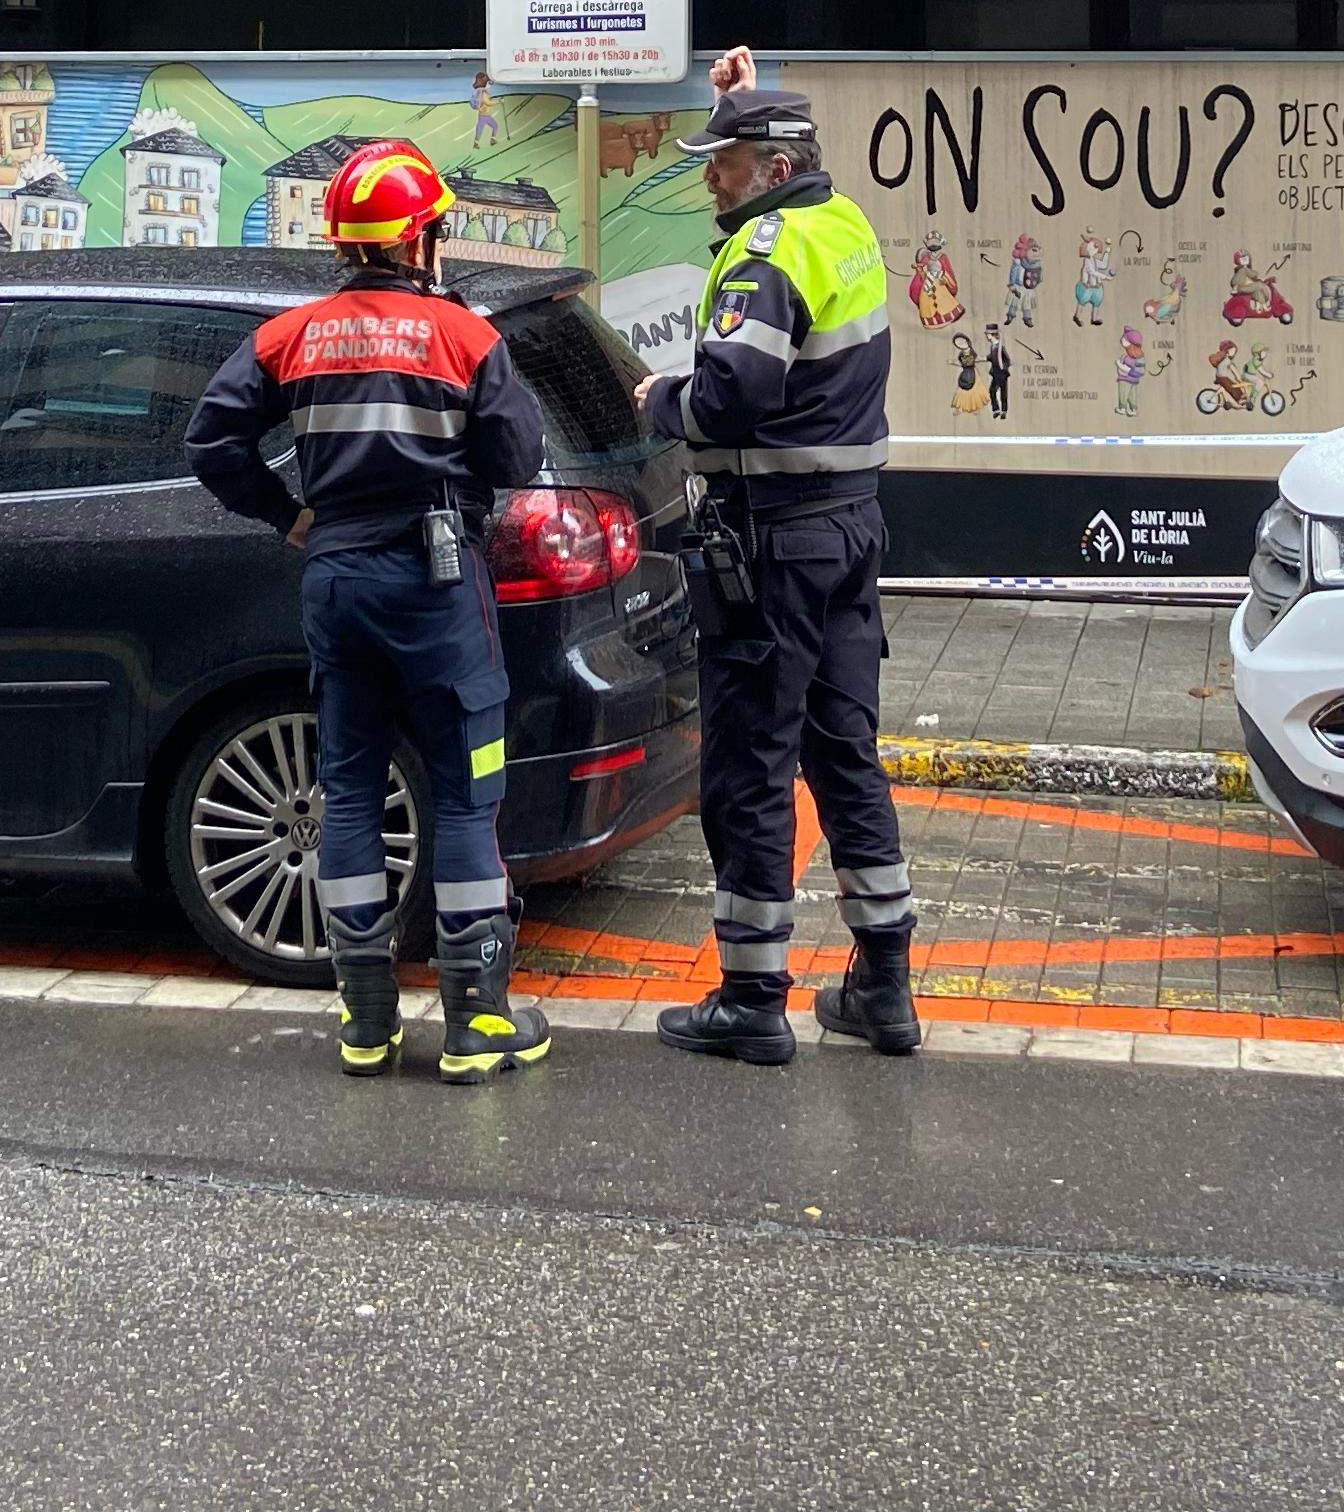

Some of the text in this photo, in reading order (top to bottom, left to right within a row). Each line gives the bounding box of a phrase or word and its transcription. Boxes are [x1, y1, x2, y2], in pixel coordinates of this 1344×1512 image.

[530, 0, 573, 15] Càrrega
[582, 0, 644, 14] descàrrega
[530, 17, 578, 30] Turismes
[586, 16, 643, 30] furgonetes
[584, 37, 597, 47] 30
[599, 36, 618, 47] min.
[514, 52, 526, 63] de
[528, 51, 540, 62] 8h
[542, 54, 548, 62] a
[551, 51, 579, 62] 13h30
[587, 51, 599, 61] de
[602, 50, 631, 61] 15h30
[633, 52, 639, 60] a
[642, 49, 659, 60] 20h
[542, 67, 592, 78] Laborables
[869, 84, 1255, 218] ON SOU?
[1278, 154, 1309, 179] ELS
[305, 316, 433, 341] BOMBERS
[303, 337, 428, 364] D'ANDORRA
[1131, 508, 1207, 528] SANT JULIÀ
[1131, 526, 1190, 545] DE LÒRIA
[1133, 549, 1174, 565] Viu-la
